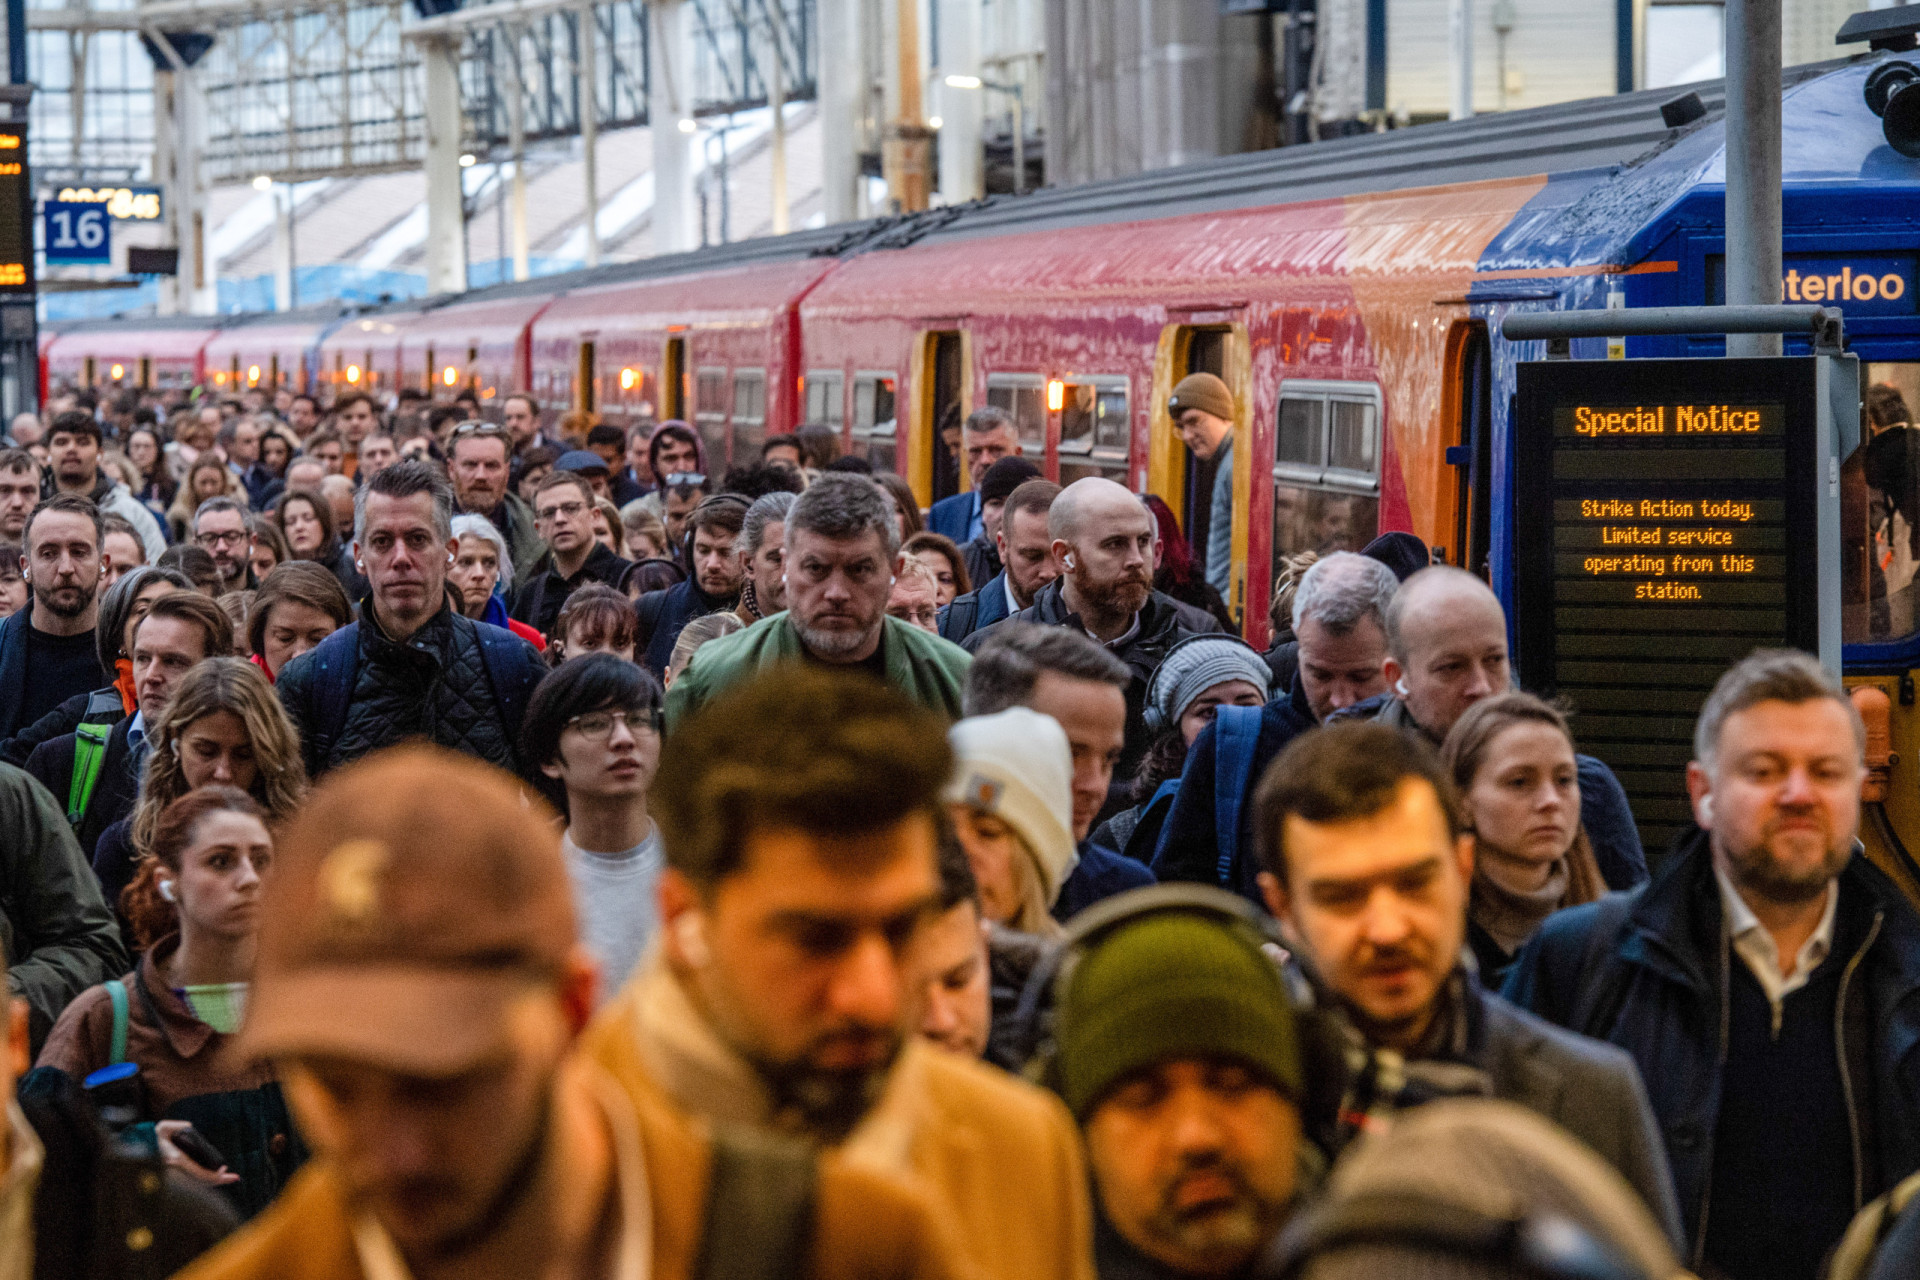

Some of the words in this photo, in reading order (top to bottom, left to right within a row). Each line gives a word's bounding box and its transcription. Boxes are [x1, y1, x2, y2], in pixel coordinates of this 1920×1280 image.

[51, 210, 104, 249] 16
[1782, 268, 1903, 301] terloo
[1576, 406, 1664, 437] Special
[1677, 406, 1760, 432] Notice
[1582, 500, 1633, 517] Strike
[1641, 500, 1693, 517] Action
[1701, 500, 1754, 521] today.
[1603, 527, 1660, 544] Limited
[1668, 528, 1732, 545] service
[1584, 555, 1665, 575] operating
[1672, 555, 1713, 572] from
[1721, 555, 1754, 572] this
[1636, 582, 1701, 599] station.
